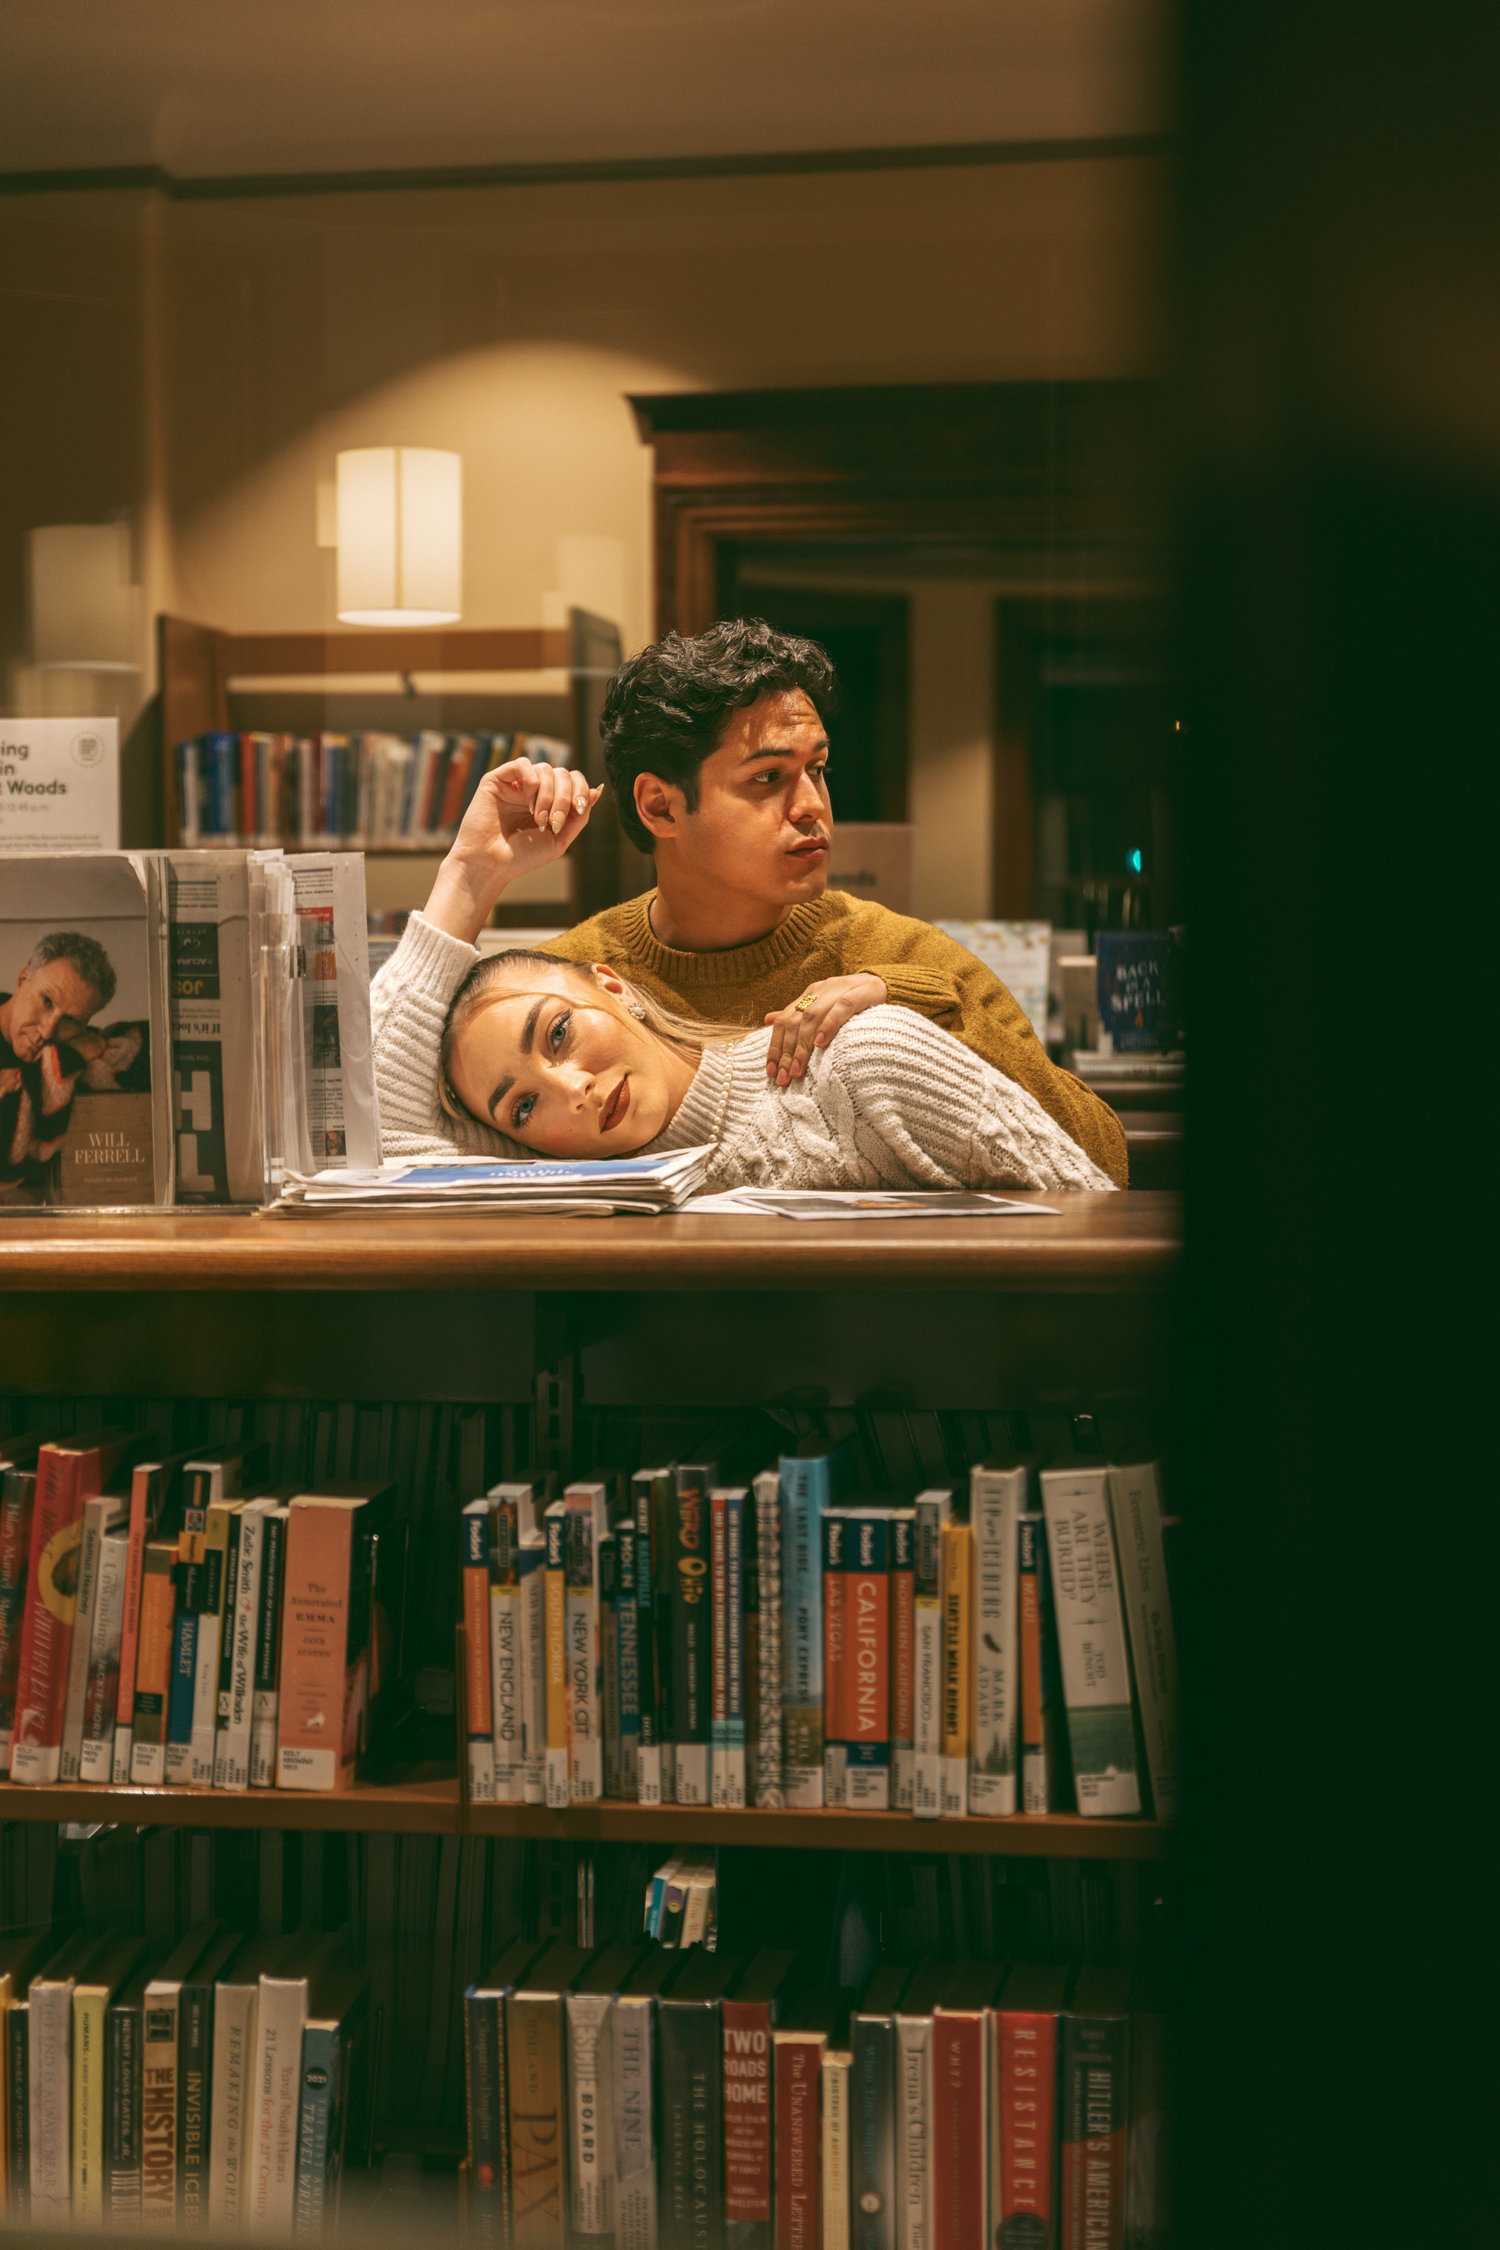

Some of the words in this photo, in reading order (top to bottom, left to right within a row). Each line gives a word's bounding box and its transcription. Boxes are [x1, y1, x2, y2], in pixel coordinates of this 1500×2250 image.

[6, 780, 67, 795] Woods
[1116, 960, 1158, 981] BACK
[1110, 989, 1166, 1012] SPELL
[193, 1023, 208, 1034] it's
[211, 1023, 221, 1034] If
[74, 1149, 145, 1165] FERRELL
[89, 1132, 130, 1147] WILL
[796, 1473, 808, 1498] THE
[4, 1503, 20, 1541] Hilary
[677, 1487, 703, 1550] WEIRD
[796, 1508, 808, 1538] LAST
[1071, 1510, 1091, 1551] ARE
[1128, 1489, 1149, 1555] Eccentric
[81, 1529, 95, 1570] Seamus
[241, 1526, 256, 1558] Zadie
[468, 1519, 483, 1561] Fodor's
[547, 1521, 563, 1565] Fodor's
[796, 1545, 809, 1573] RIDE
[827, 1523, 842, 1565] Fodor's
[859, 1524, 873, 1567] Fodor's
[895, 1522, 909, 1564] Fodor's
[1020, 1526, 1036, 1567] Fodor's
[1054, 1520, 1078, 1600] BURIED?
[1094, 1522, 1113, 1593] WHERE
[1, 1545, 15, 1590] Mantel
[240, 1560, 254, 1594] Smith
[619, 1536, 634, 1588] MOON
[637, 1540, 651, 1608] NASHVILLE
[1074, 1555, 1097, 1608] THEY
[1136, 1556, 1152, 1592] Lives
[78, 1574, 92, 1614] Heaney
[266, 1576, 275, 1596] BOOK
[291, 1596, 342, 1609] Annotated
[308, 1583, 326, 1593] The
[550, 1583, 561, 1625] SOUTH
[828, 1580, 841, 1606] LAS
[1023, 1582, 1036, 1622] MAUI
[296, 1612, 335, 1624] EMMA
[498, 1612, 514, 1651] NEW
[572, 1612, 587, 1651] NEW
[797, 1608, 808, 1642] PONY
[896, 1579, 908, 1650] NORTHERN
[946, 1594, 958, 1647] SEATTLE
[178, 1621, 194, 1677] HAMLET
[236, 1629, 250, 1659] Wife
[550, 1628, 562, 1685] FLORIDA
[620, 1599, 638, 1715] TENNESSEE
[828, 1612, 842, 1662] VEGAS
[856, 1581, 878, 1733] CALIFORNIA
[921, 1625, 932, 1651] SAN
[93, 1658, 107, 1699] JACKIE
[573, 1657, 589, 1705] YORK
[797, 1647, 809, 1704] EXPRESS
[946, 1649, 958, 1683] WALK
[1082, 1641, 1097, 1689] BENOIT
[1096, 1650, 1107, 1679] TOD
[498, 1657, 515, 1742] ENGLAND
[897, 1654, 909, 1731] CALIFORNIA
[921, 1653, 932, 1722] FRANCISCO
[977, 1666, 990, 1727] ADAMS
[993, 1670, 1004, 1723] MARK
[947, 1688, 958, 1737] REPORT
[43, 2036, 55, 2067] END
[121, 2018, 131, 2057] HENRY
[264, 2028, 276, 2041] 21
[476, 2017, 492, 2084] Cleopatra's
[573, 2009, 599, 2088] RESCUE
[622, 2028, 639, 2079] THE
[723, 2030, 767, 2055] TWO
[15, 2045, 23, 2083] PRAISE
[121, 2061, 130, 2095] LOUIS
[145, 2067, 174, 2085] THE
[228, 2026, 242, 2131] REMAKING
[262, 2047, 276, 2095] Lessons
[279, 2066, 294, 2100] Yuval
[306, 2073, 328, 2084] 2021
[791, 2054, 805, 2079] The
[863, 2046, 875, 2084] When
[905, 2047, 925, 2116] Irena's
[951, 2041, 961, 2089] WHY?
[15, 2087, 24, 2100] OF
[262, 2098, 274, 2118] for
[692, 2072, 706, 2111] THE
[864, 2088, 876, 2118] Time
[1086, 2070, 1113, 2153] HITLER'S
[43, 2089, 55, 2142] ALWAYS
[120, 2098, 130, 2138] GATES,
[184, 2070, 202, 2164] INVISIBLE
[262, 2119, 273, 2139] the
[279, 2103, 292, 2138] Noah
[477, 2086, 492, 2141] Daughter
[580, 2093, 595, 2165] BOARD
[623, 2090, 641, 2151] NINE
[1012, 2029, 1037, 2208] RESISTANCE
[15, 2105, 24, 2171] FORGETTING
[121, 2141, 131, 2160] JR.
[143, 2087, 174, 2202] HISTORY
[228, 2137, 237, 2152] the
[300, 2103, 315, 2166] TRAVEL
[862, 2122, 876, 2174] Stopped
[43, 2148, 55, 2188] NEAR
[111, 2168, 140, 2192] THE
[276, 2141, 290, 2183] Harari
[511, 2108, 559, 2221] PAX
[907, 2119, 926, 2205] Children
[224, 2157, 237, 2223] WORLD
[255, 2165, 271, 2219] Century
[692, 2122, 707, 2250] HOLOCAUST
